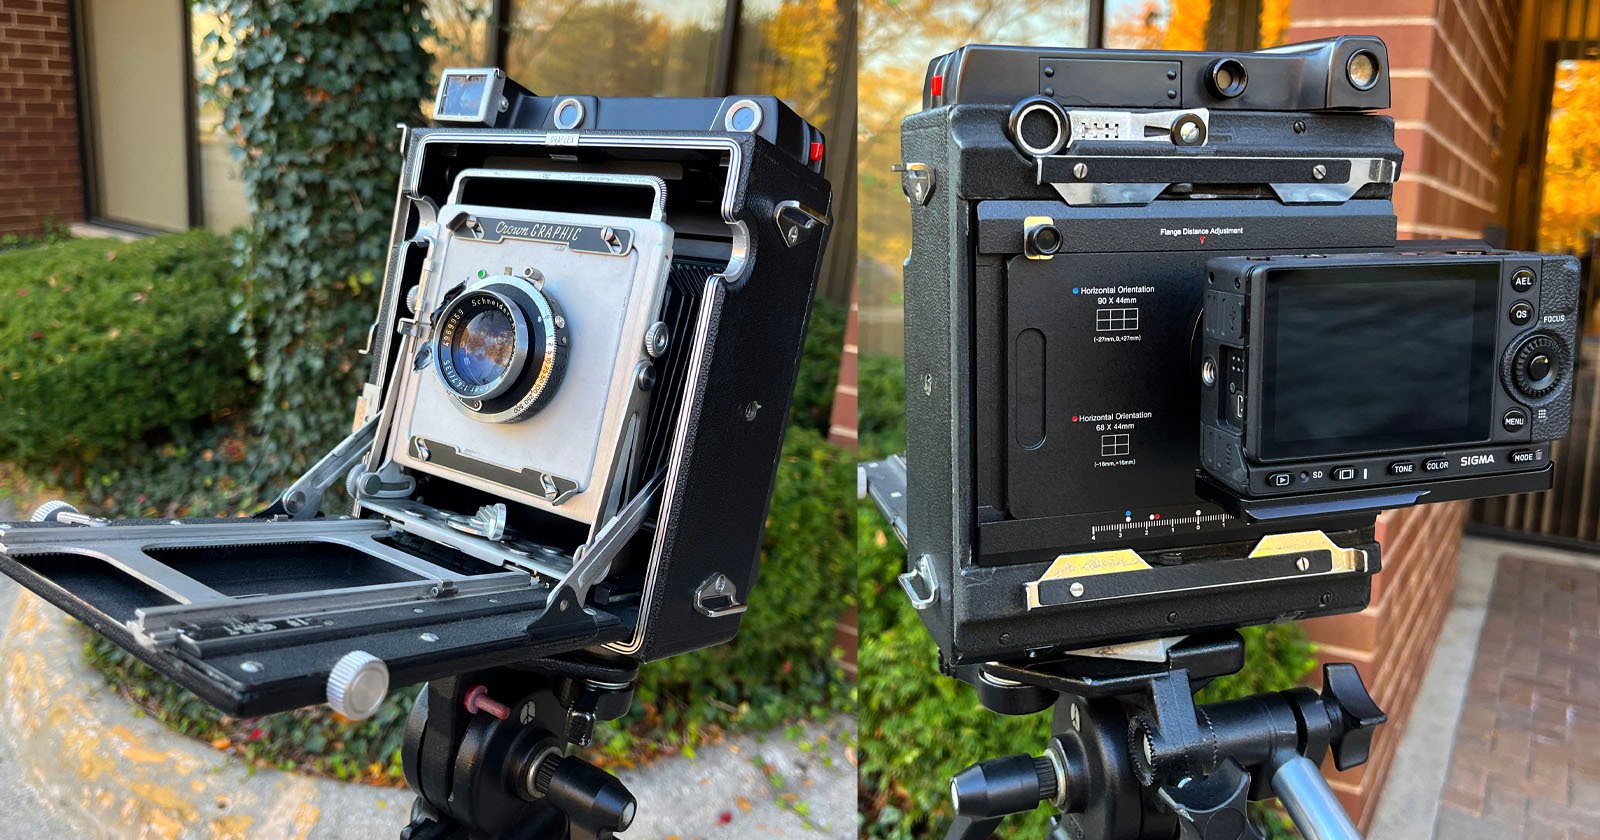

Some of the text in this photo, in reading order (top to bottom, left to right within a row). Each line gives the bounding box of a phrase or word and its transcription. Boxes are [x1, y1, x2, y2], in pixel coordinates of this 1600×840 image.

[495, 221, 582, 241] Crown GRAPHIC
[1160, 228, 1182, 236] Flange
[1210, 227, 1244, 236] Adjustment
[1516, 278, 1532, 286] AEL
[1080, 285, 1155, 294] Horizontal Orientation
[1516, 310, 1527, 318] QS
[1543, 314, 1565, 323] FOCUS
[1079, 411, 1152, 422] Horizontal Orientation
[1460, 454, 1495, 466] SIGMA
[1514, 453, 1534, 462] MODE
[1394, 464, 1413, 473] TONE
[1426, 461, 1449, 470] COLOR
[1312, 470, 1323, 479] SD
